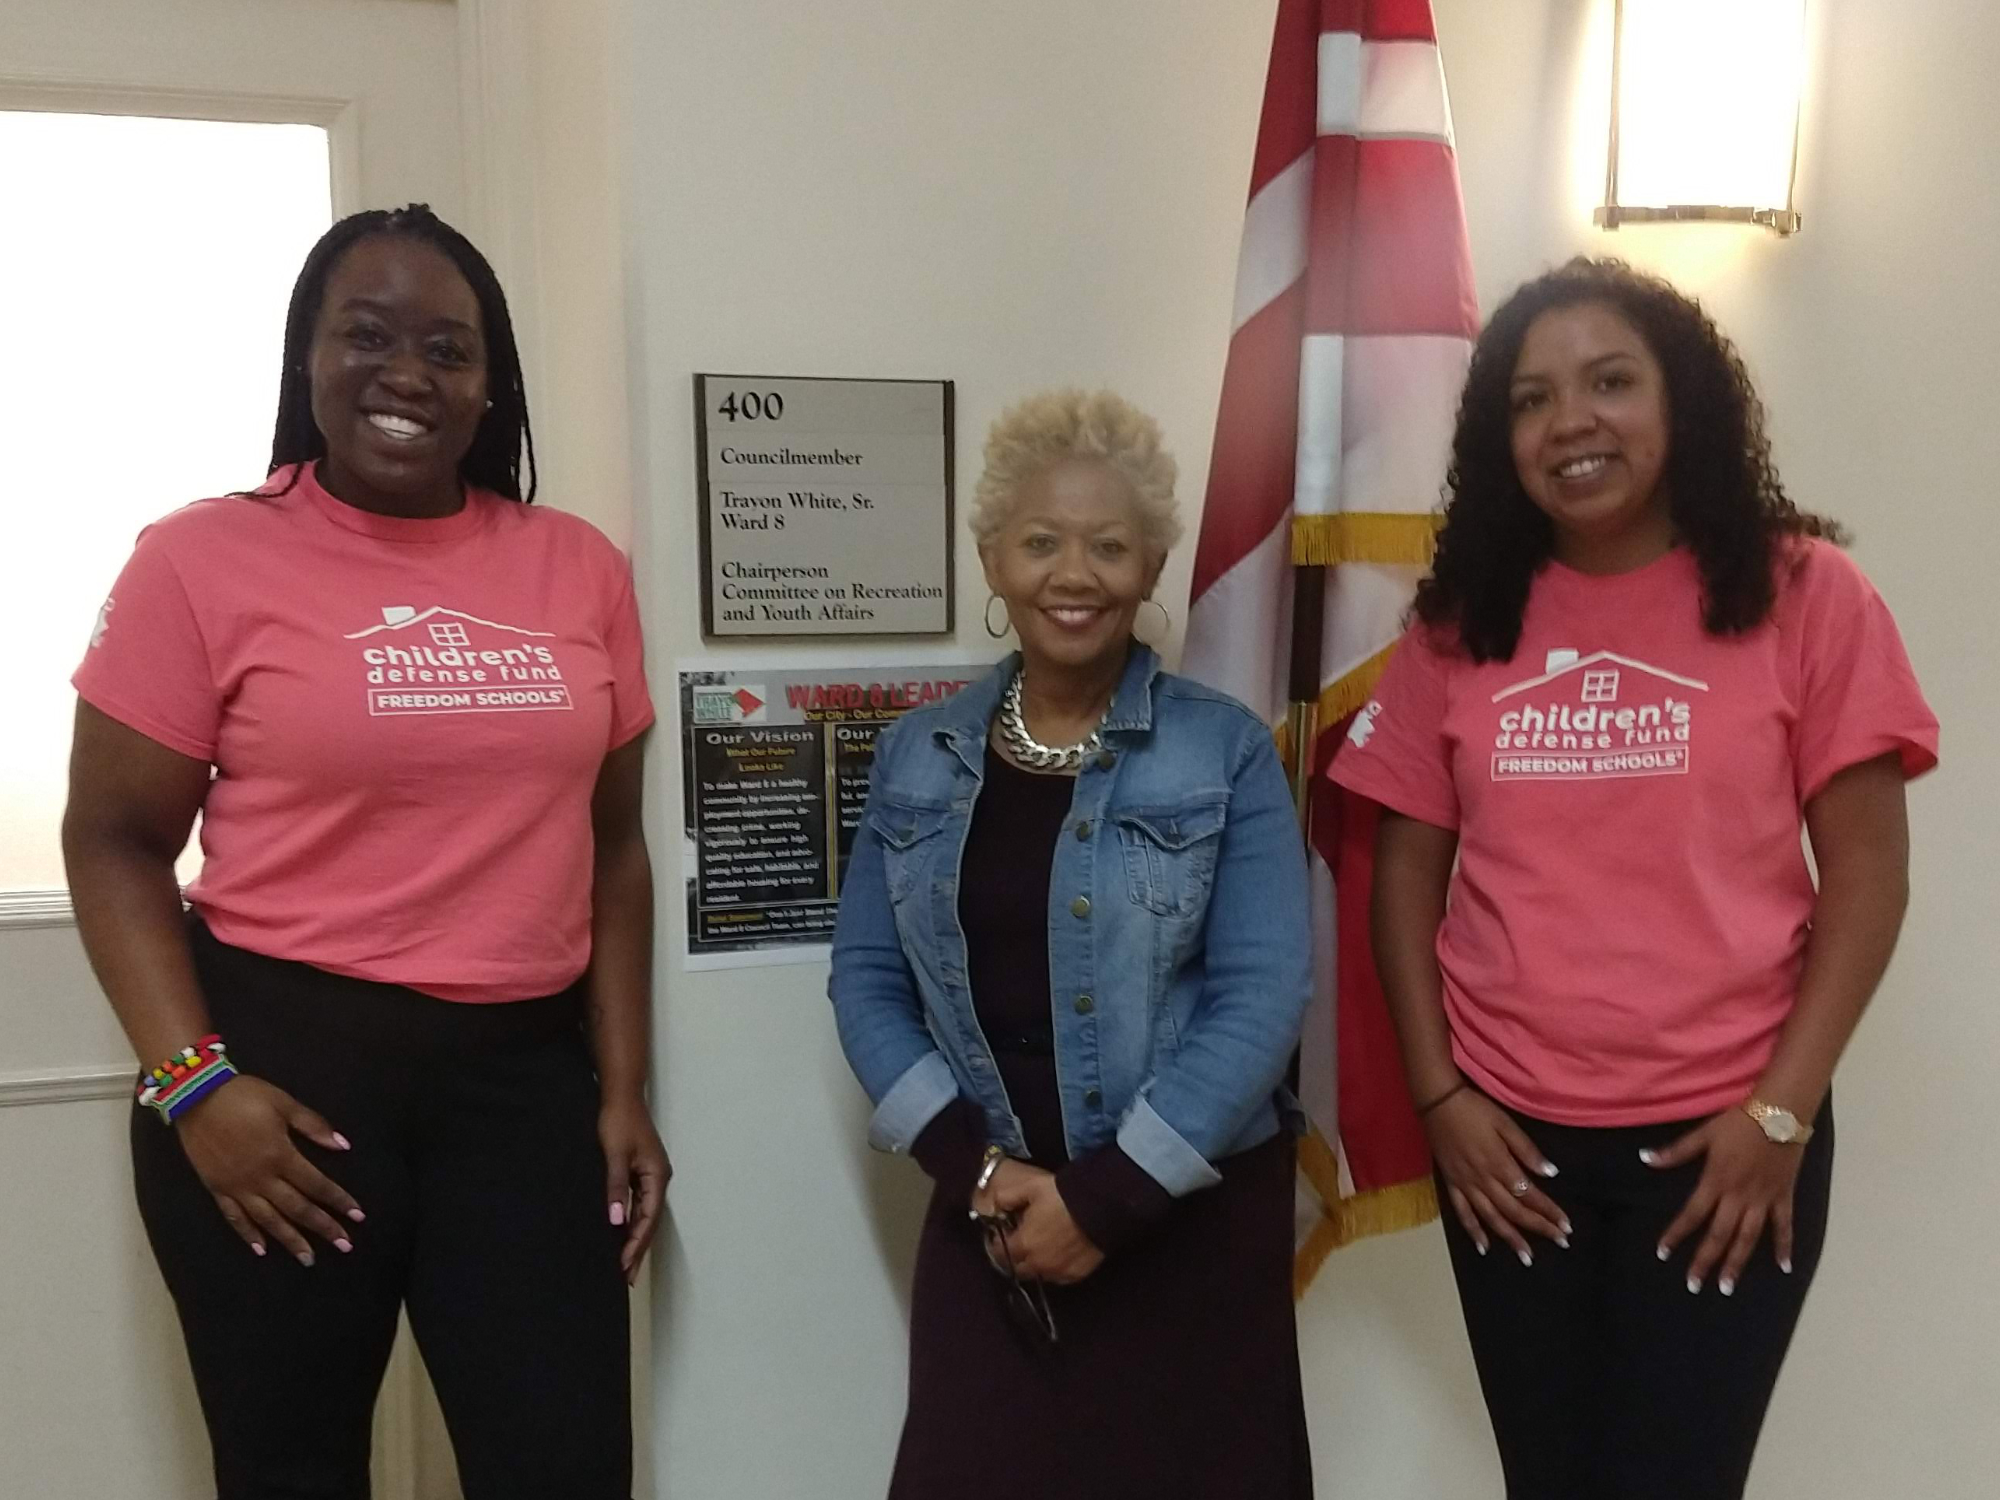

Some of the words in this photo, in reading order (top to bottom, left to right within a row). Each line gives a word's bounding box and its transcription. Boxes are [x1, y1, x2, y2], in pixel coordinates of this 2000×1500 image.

[718, 391, 784, 422] 400
[720, 447, 863, 465] Councilmember
[720, 491, 782, 511] Trayon
[788, 491, 847, 511] White,
[852, 493, 875, 509] Sr.
[721, 513, 769, 530] Ward
[774, 514, 786, 530] 8
[722, 561, 829, 582] Chairperson
[722, 583, 819, 600] Committee
[824, 586, 846, 600] on
[851, 583, 943, 600] Recreation
[722, 605, 755, 621] and
[761, 605, 812, 621] Youth
[818, 604, 875, 621] Affairs
[363, 643, 555, 667] children's
[367, 666, 488, 684] defense
[500, 665, 563, 681] fund
[377, 693, 471, 708] FREEDOM
[786, 681, 864, 709] WARD
[1500, 697, 1691, 732] children's
[706, 732, 745, 745] Our
[750, 730, 815, 743] Vision
[836, 728, 875, 741] Our
[1495, 731, 1612, 750] defense
[1625, 725, 1690, 746] fund
[1498, 757, 1588, 774] FREEDOM
